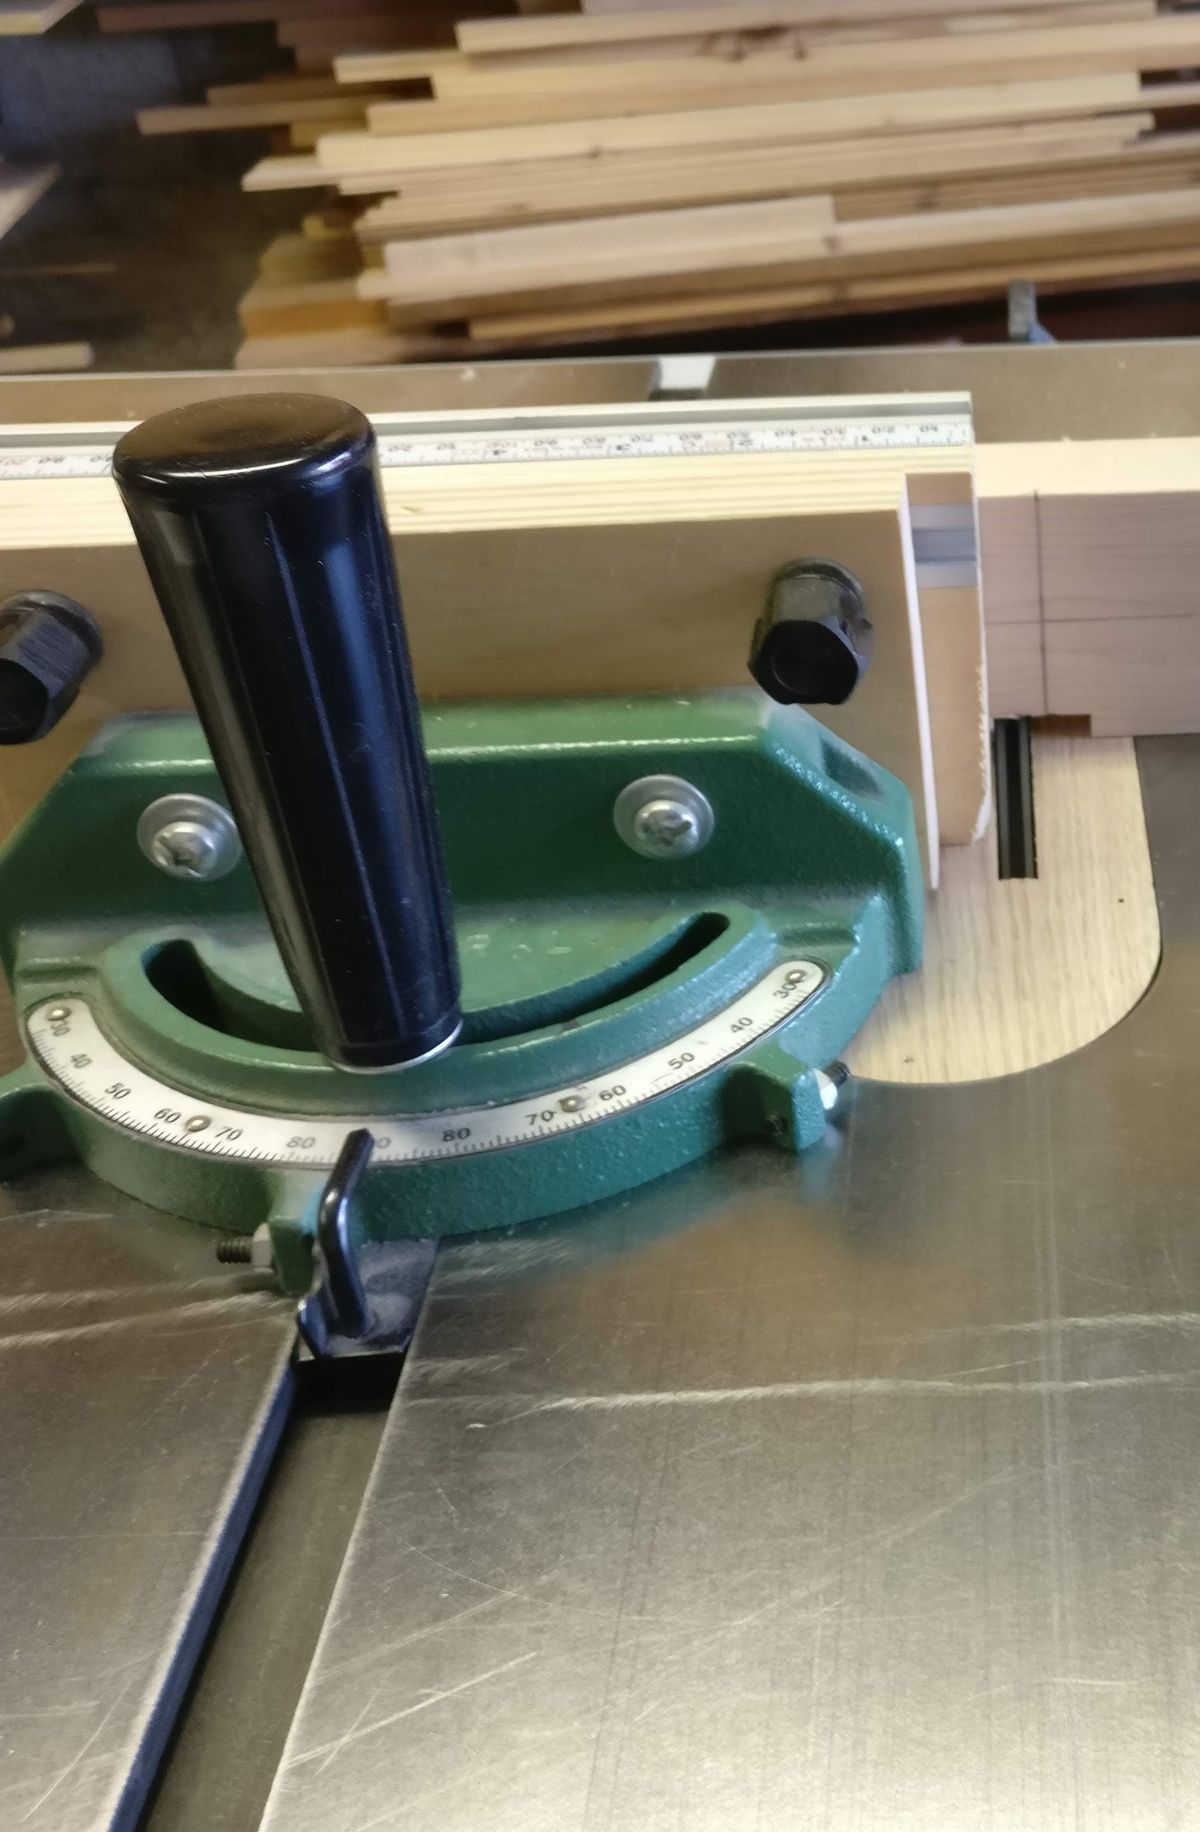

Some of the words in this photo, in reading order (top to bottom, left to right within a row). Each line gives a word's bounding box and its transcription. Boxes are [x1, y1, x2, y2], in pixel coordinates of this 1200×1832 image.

[70, 1053, 92, 1069] 40
[104, 1082, 132, 1099] 50
[154, 1108, 182, 1123] 60
[214, 1126, 243, 1141] 70
[286, 1135, 316, 1149] 80
[442, 1127, 471, 1142] 80
[525, 1109, 556, 1125] 70
[599, 1084, 627, 1101] 60
[667, 1052, 695, 1070] 50
[729, 1017, 753, 1034] 40
[772, 981, 799, 1000] 30
